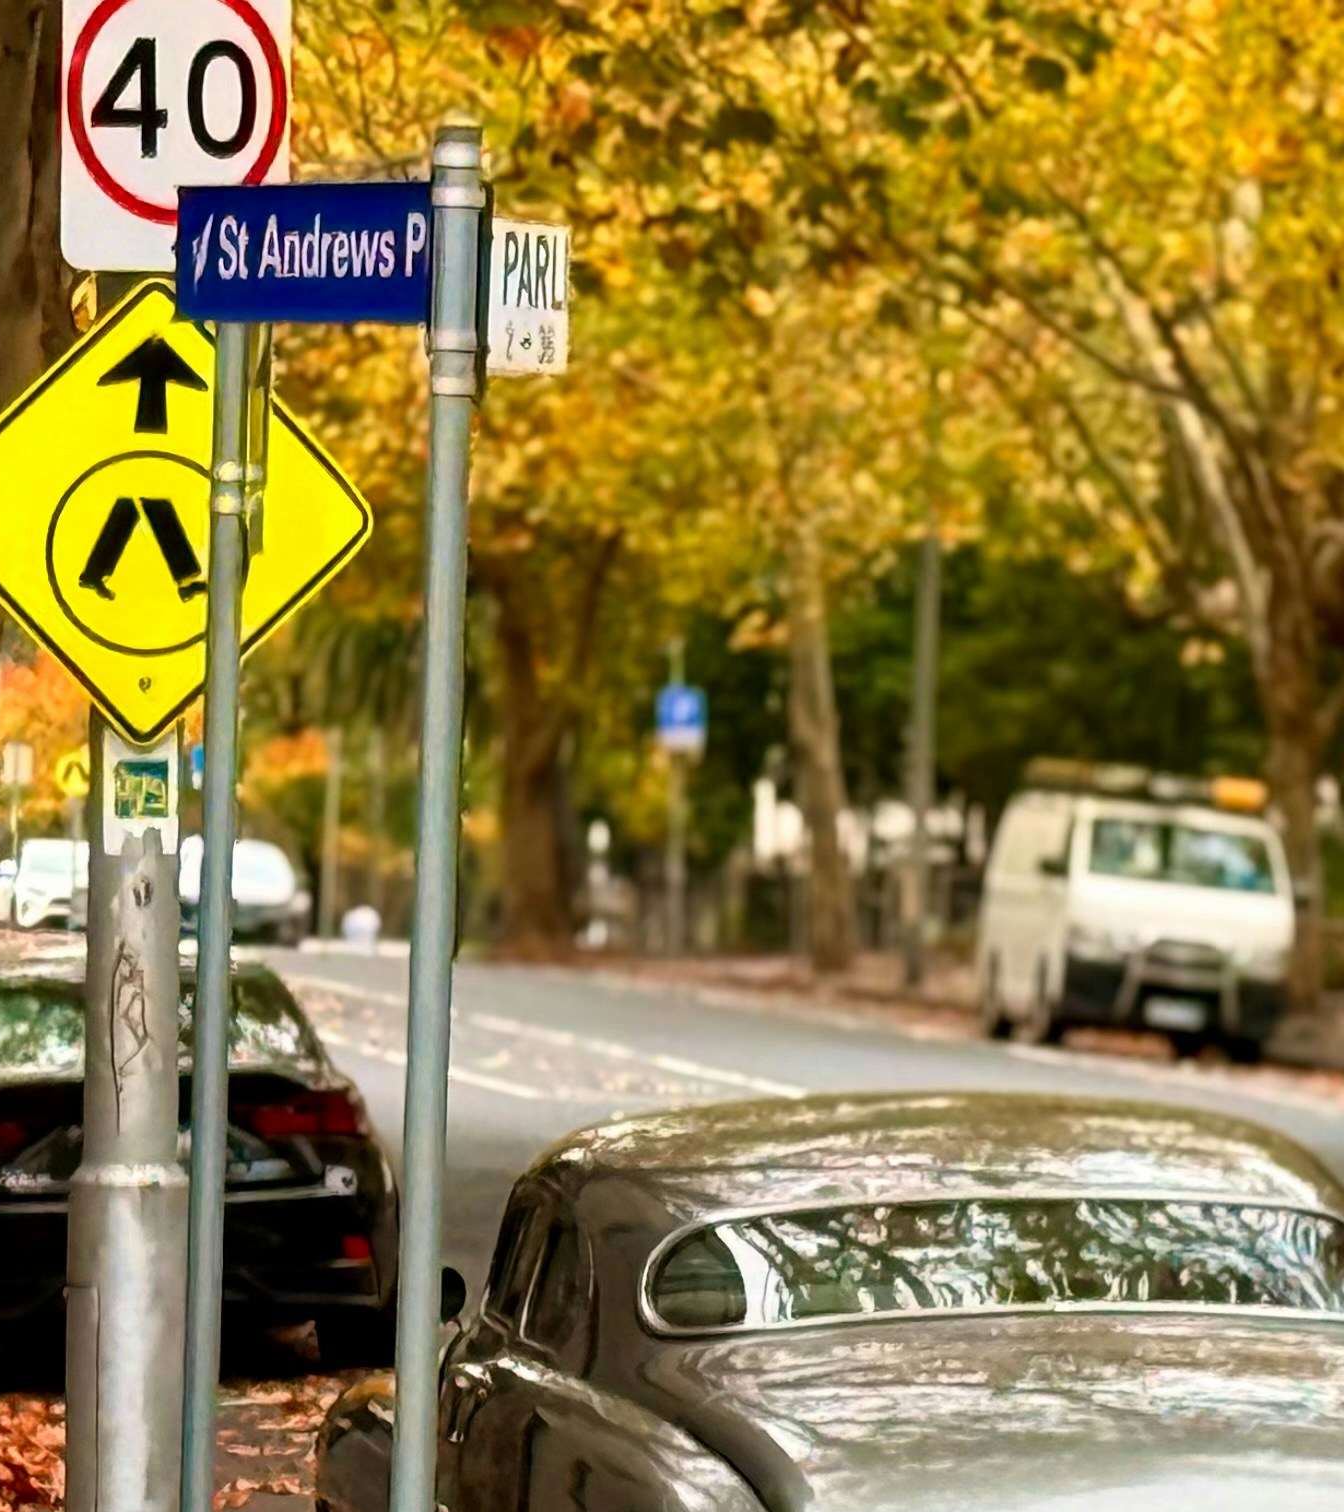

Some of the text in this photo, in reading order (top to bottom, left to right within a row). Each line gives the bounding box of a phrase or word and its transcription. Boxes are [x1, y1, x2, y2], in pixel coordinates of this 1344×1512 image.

[90, 37, 257, 159] 40
[218, 214, 248, 280] St
[258, 213, 396, 279] Andrews
